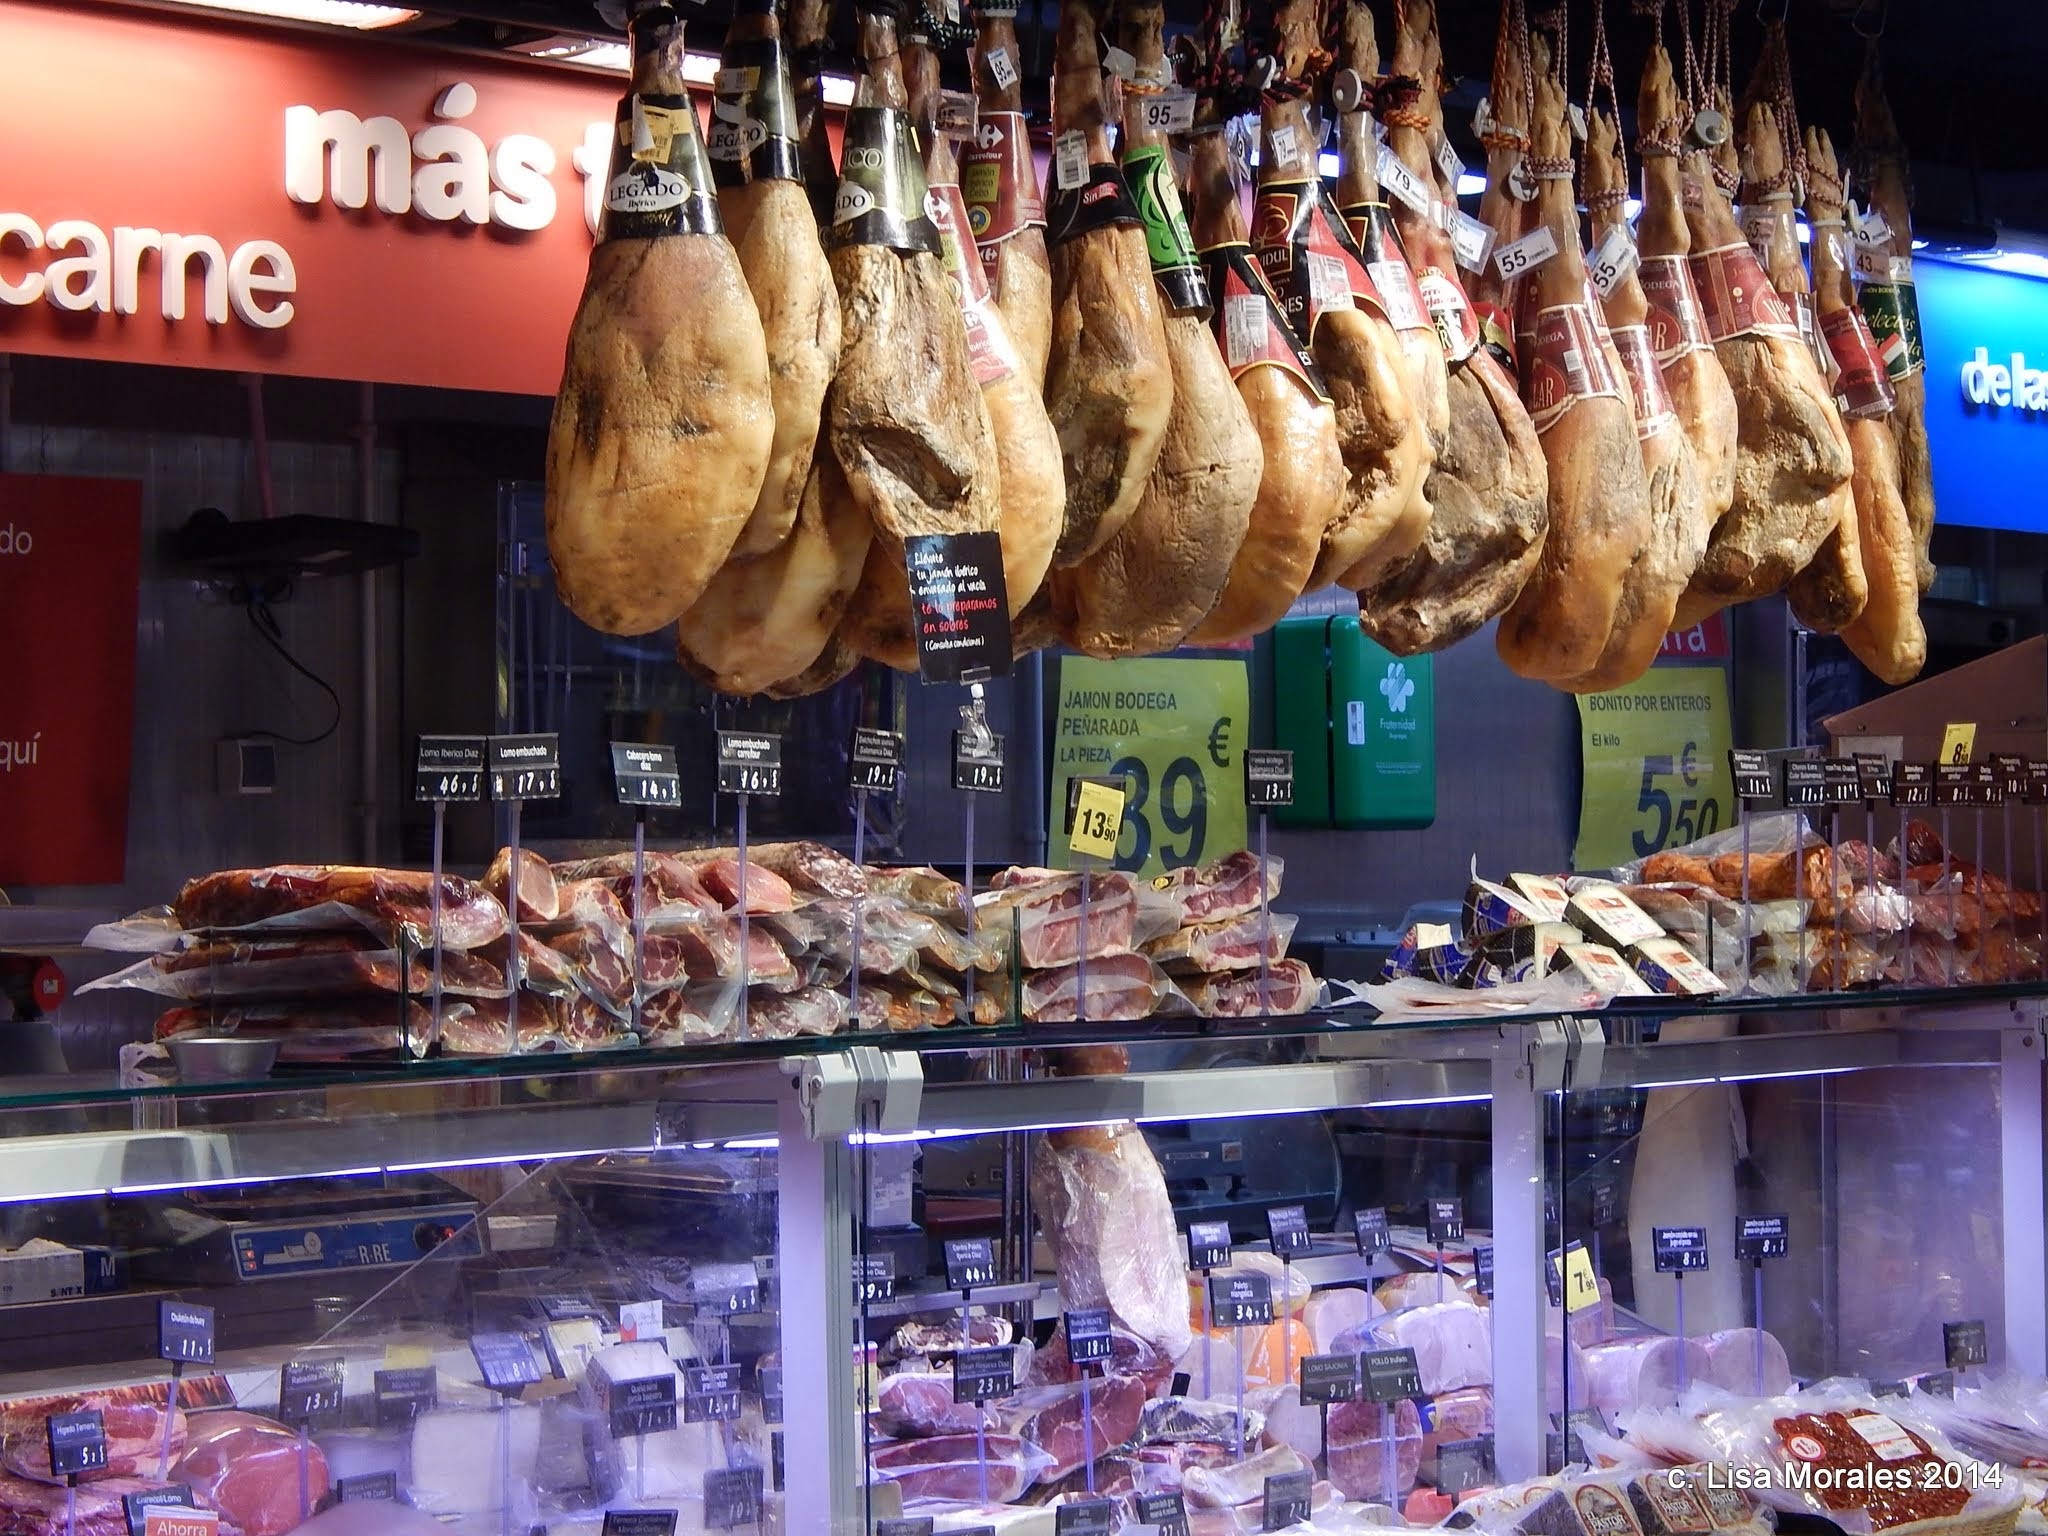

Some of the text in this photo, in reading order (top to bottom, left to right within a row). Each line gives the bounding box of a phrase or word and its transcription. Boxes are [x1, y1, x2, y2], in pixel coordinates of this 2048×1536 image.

[1148, 105, 1171, 125] 95
[284, 82, 557, 231] más
[1394, 165, 1410, 191] 79
[610, 182, 683, 201] LEGADO
[1083, 192, 1099, 205] Sin
[1502, 249, 1527, 273] 55
[1856, 254, 1873, 272] 43
[0, 213, 296, 329] carne
[1593, 262, 1616, 288] 55
[916, 571, 926, 581] tu
[918, 582, 956, 596] envasado
[958, 581, 965, 592] al
[921, 603, 931, 615] te
[946, 598, 998, 616] preparamos
[923, 619, 969, 634] en sobres
[1064, 691, 1177, 710] JAMON BODEGA
[1589, 695, 1711, 711] BONITO POR ENTEROS
[1062, 714, 1140, 735] PEÑARADA
[1380, 717, 1415, 731] Fraternidad
[1592, 734, 1620, 746] El kilo
[420, 748, 439, 757] Lomo
[500, 745, 547, 758] Lomo embuchado
[1061, 748, 1112, 762] LA PIEZA
[1632, 755, 1673, 857] 5
[1083, 808, 1106, 838] 13
[101, 1256, 116, 1277] M
[1574, 1272, 1584, 1293] 7
[1586, 1511, 1598, 1521] EL
[1662, 1501, 1691, 1516] PASTOR
[157, 1521, 207, 1536] Ahorra
[1590, 1514, 1626, 1533] PASTOR
